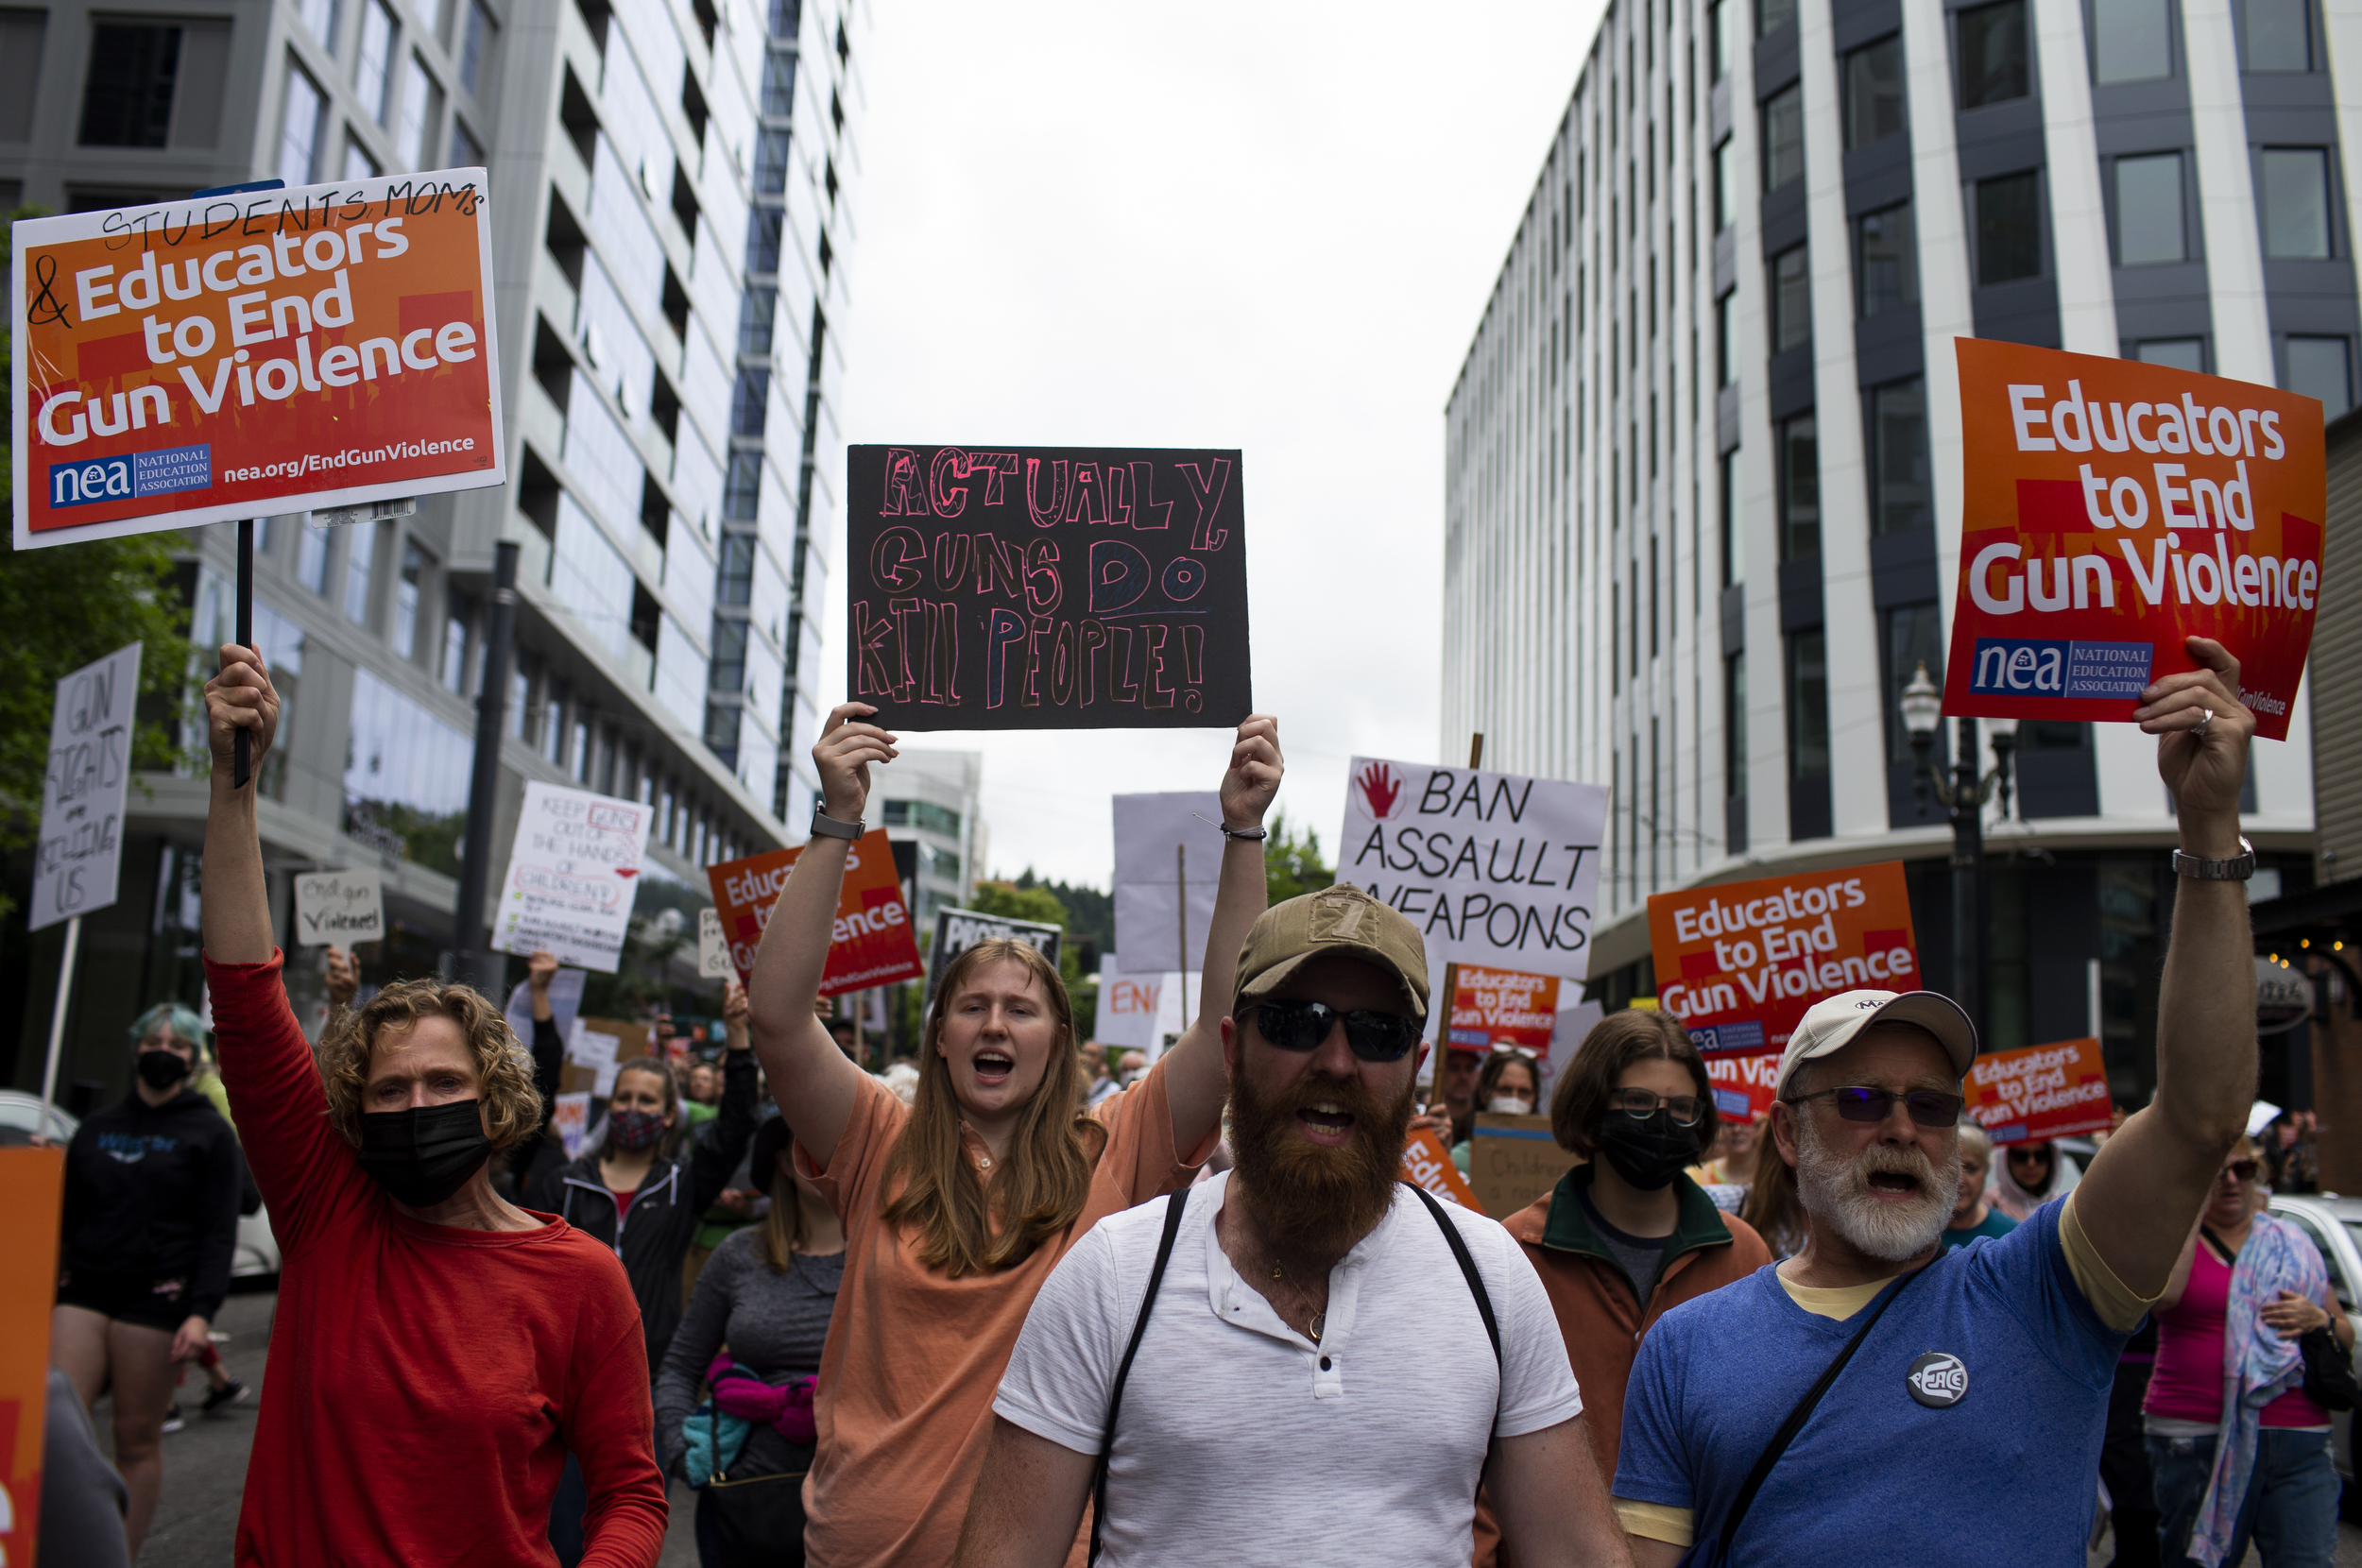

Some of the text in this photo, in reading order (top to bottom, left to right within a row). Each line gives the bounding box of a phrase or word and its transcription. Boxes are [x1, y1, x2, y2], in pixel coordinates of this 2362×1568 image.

[75, 216, 409, 321] Educators
[27, 254, 73, 329] &
[143, 268, 355, 365] to End
[38, 320, 477, 447] Gun Violence
[2007, 379, 2285, 461] Educators
[54, 461, 131, 503] nea
[138, 451, 208, 469] NATIONAL
[139, 464, 208, 481] EDUCATION
[224, 437, 474, 484] nea.org/EndGunViolence
[139, 474, 209, 493] ASSOCIATION
[2080, 459, 2255, 531] to End
[871, 525, 1207, 617] GUNS DO
[1969, 532, 2318, 616] Gun Violence
[986, 607, 1204, 714] PEOPLE!
[1974, 645, 2062, 690] nea
[2072, 665, 2148, 678] EDUCATION
[2074, 648, 2149, 663] NATIONAL
[2070, 680, 2147, 692] ASSOCIATION
[2237, 685, 2286, 716] GunViolence
[1418, 770, 1533, 824] BAN
[724, 845, 862, 908] Educas
[1355, 823, 1600, 891] ASSAULT
[830, 900, 906, 943] ence
[1325, 896, 1367, 941] 7
[1672, 878, 1866, 944] Educators
[1714, 912, 1839, 972] to End
[1457, 968, 1547, 994] Educators
[1474, 990, 1532, 1010] to End
[1661, 946, 1913, 1020] Gun Violence
[1485, 1008, 1554, 1031] Violence
[1688, 1027, 1720, 1051] ea
[1972, 1045, 2080, 1086] Educators
[1995, 1067, 2066, 1100] to End
[2011, 1080, 2108, 1116] Violence
[1908, 1359, 1963, 1400] PEACE
